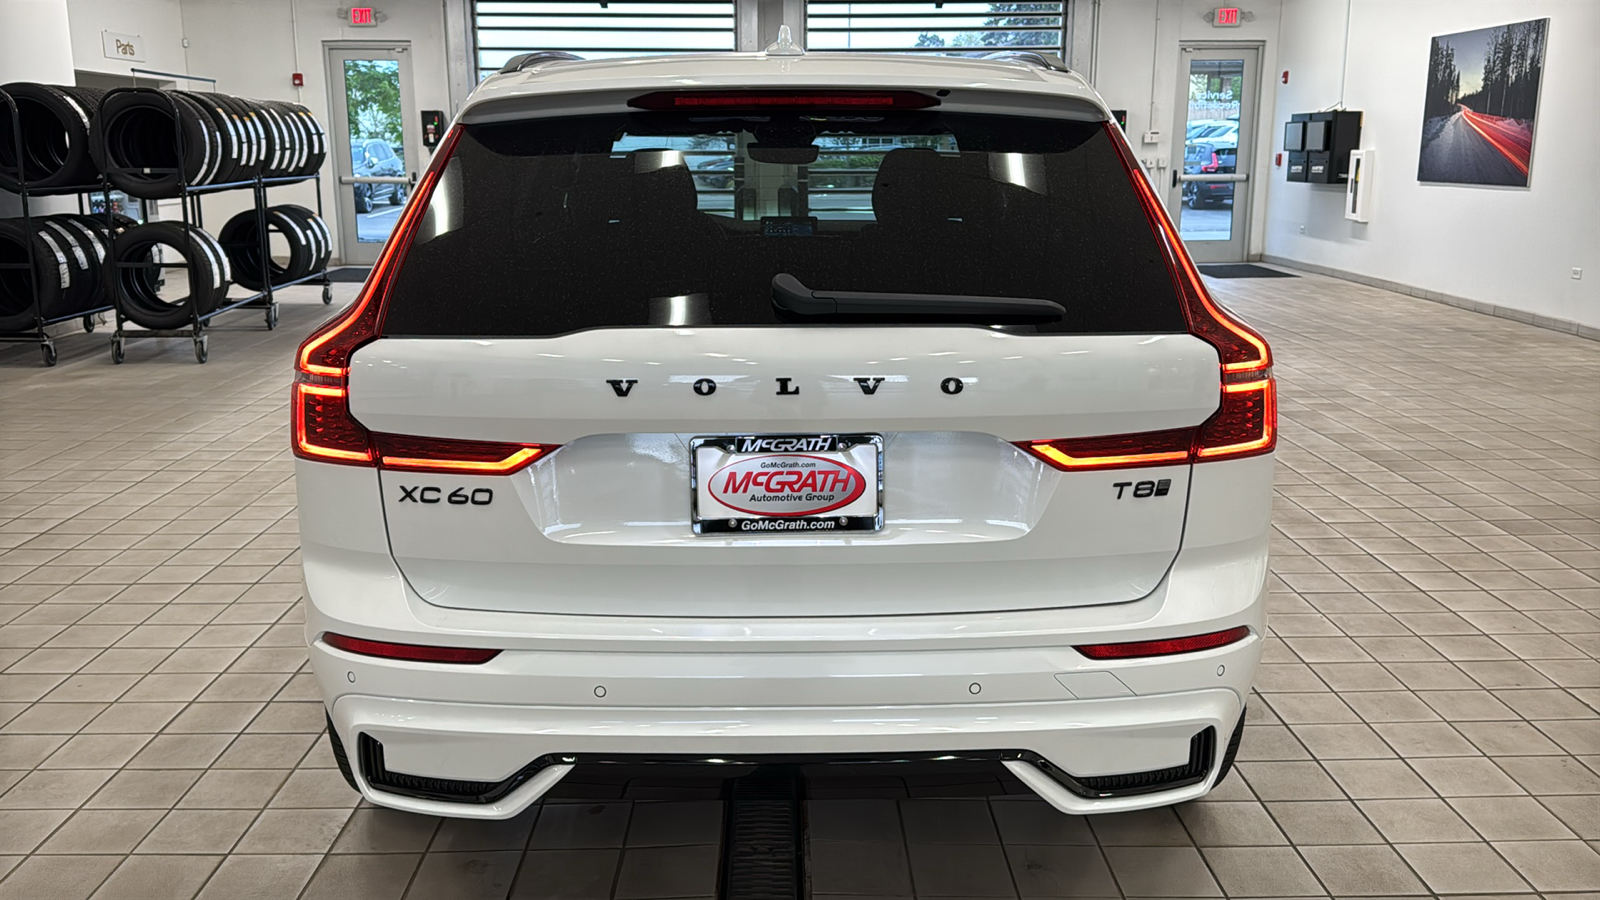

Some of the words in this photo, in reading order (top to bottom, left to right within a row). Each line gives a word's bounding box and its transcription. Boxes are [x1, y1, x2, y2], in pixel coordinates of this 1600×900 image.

[351, 7, 372, 24] EXIT
[1218, 7, 1239, 24] EXIT
[115, 38, 135, 56] Parts
[606, 377, 964, 397] VOLVO
[760, 461, 816, 470] GoMcGrath.com
[749, 493, 802, 503] Automotive
[805, 493, 835, 504] Group
[1112, 480, 1156, 500] T8
[741, 520, 835, 531] GoMcGrath.com
